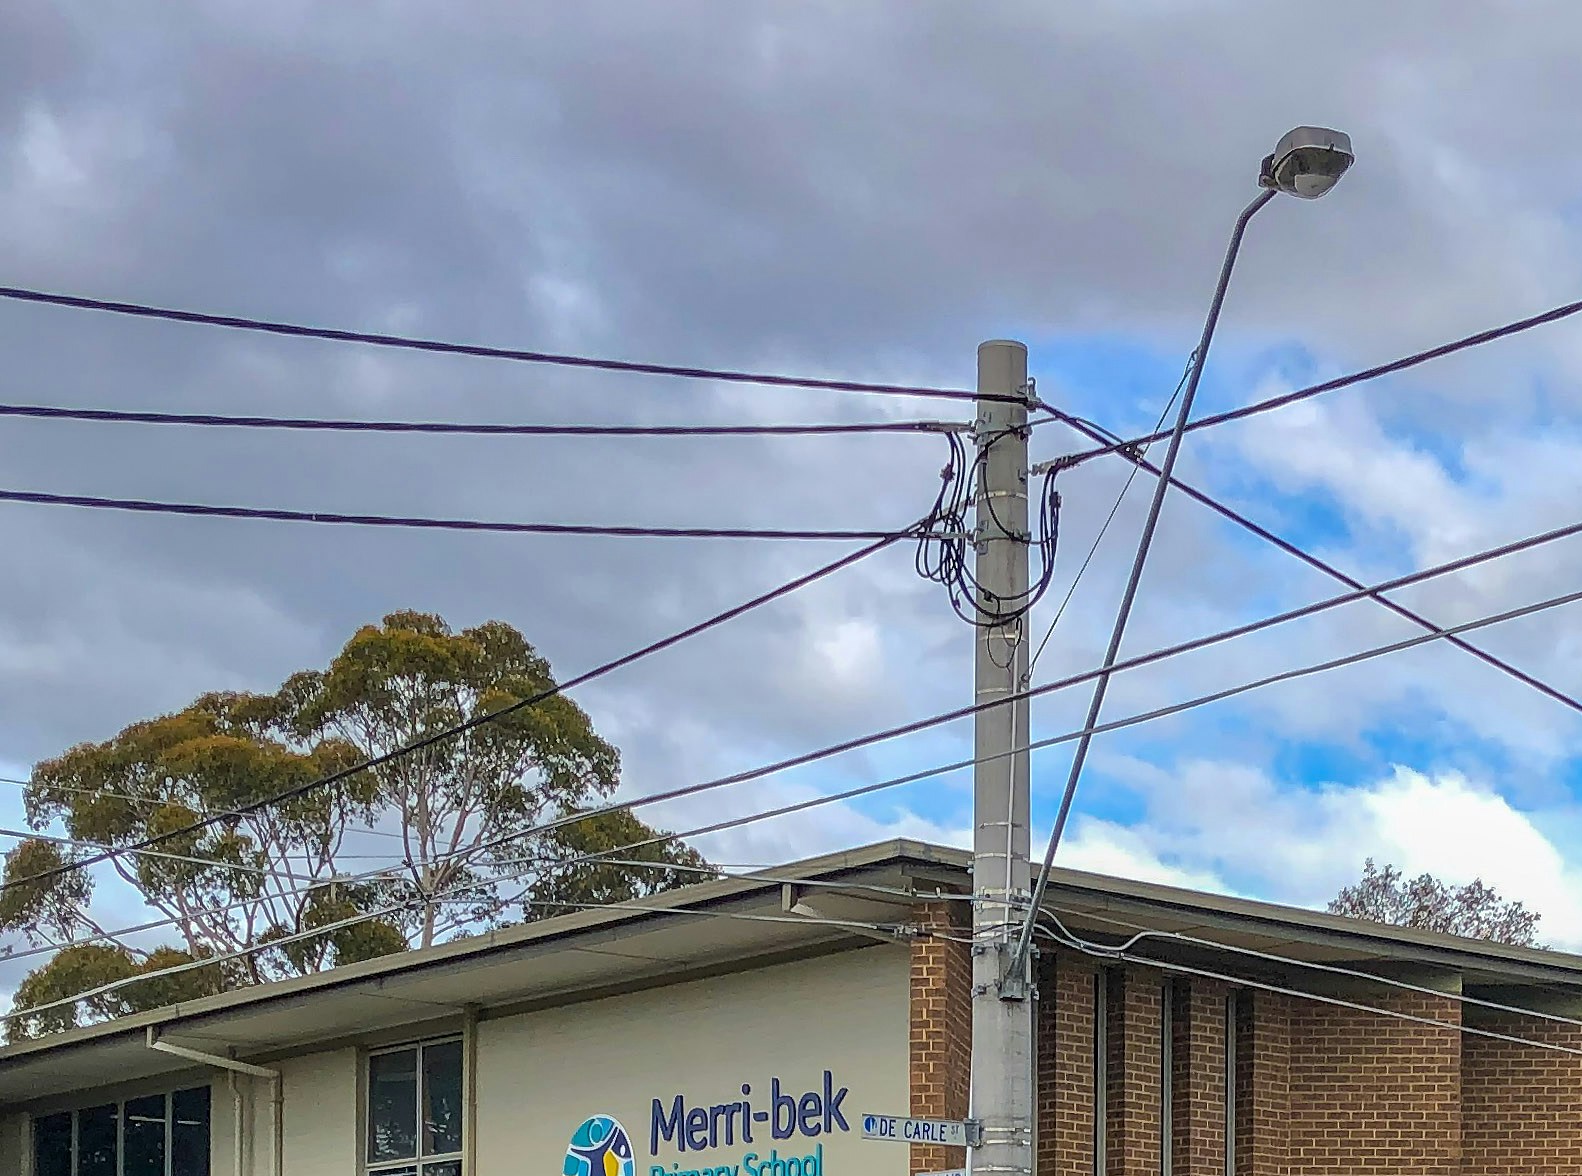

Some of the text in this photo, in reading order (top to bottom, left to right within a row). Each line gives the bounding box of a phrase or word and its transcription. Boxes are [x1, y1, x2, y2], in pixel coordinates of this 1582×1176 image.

[651, 1070, 850, 1156] Merri-bek
[879, 1118, 896, 1137] DE
[904, 1120, 948, 1142] CARLE
